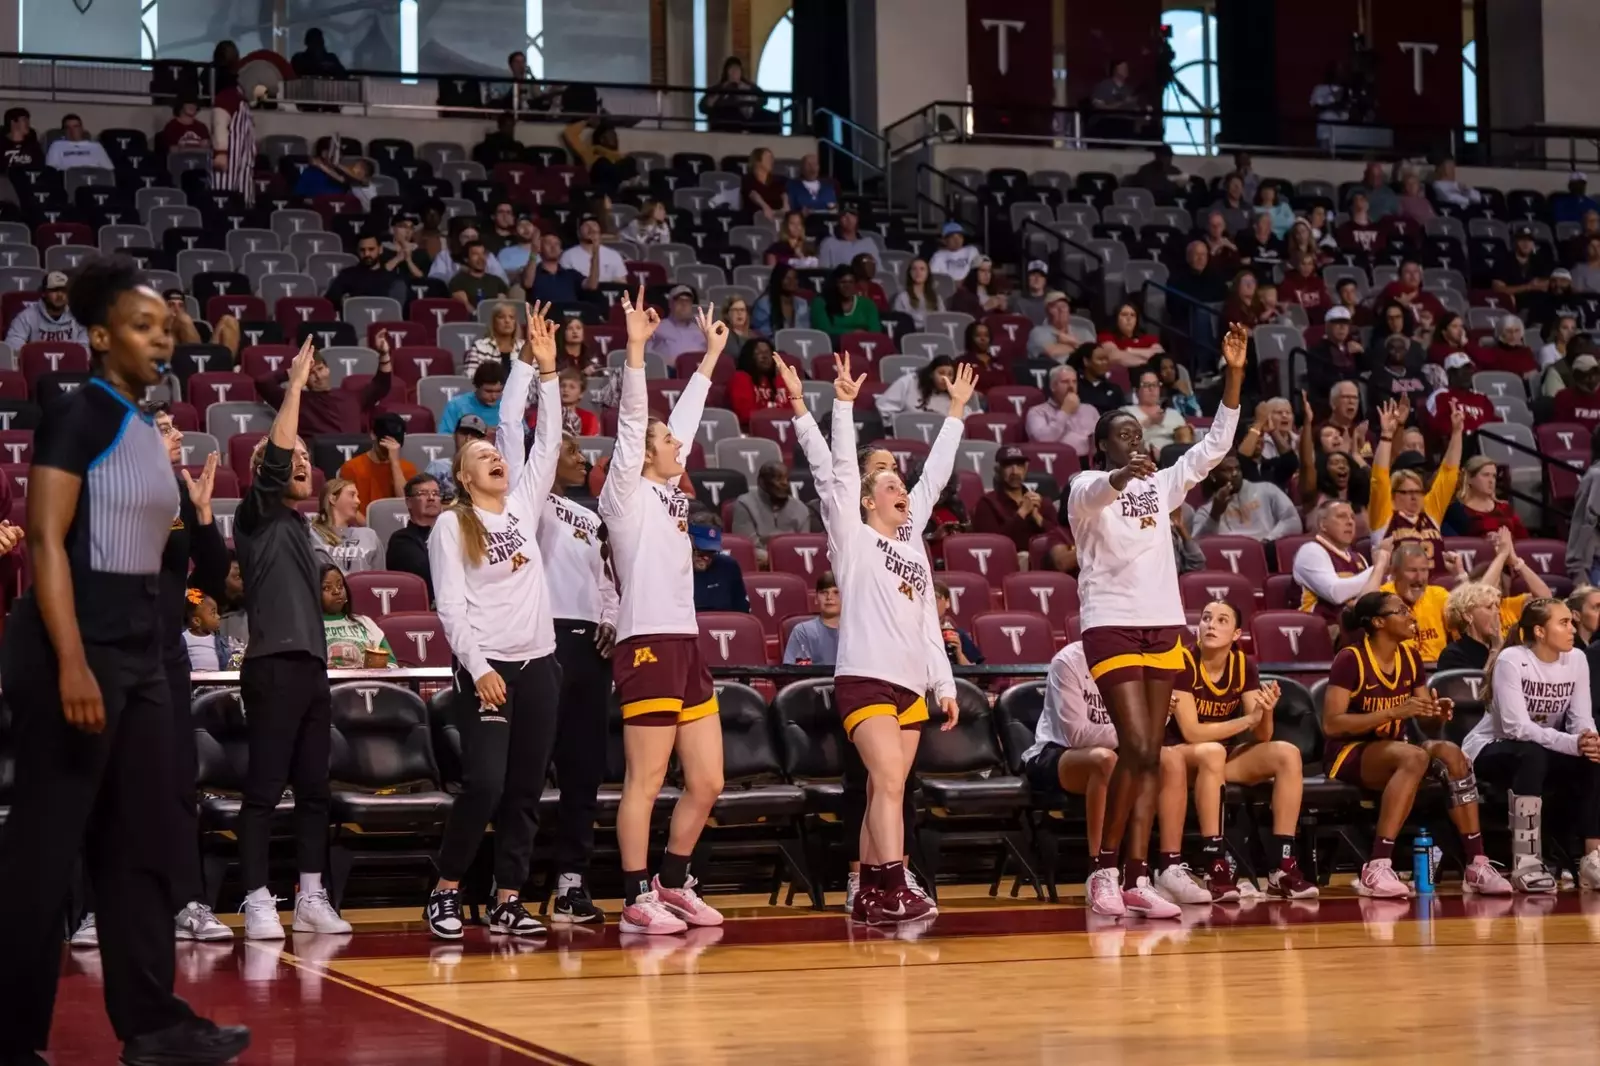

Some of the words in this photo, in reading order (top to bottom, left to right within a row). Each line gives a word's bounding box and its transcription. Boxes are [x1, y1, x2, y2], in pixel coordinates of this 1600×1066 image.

[981, 19, 1025, 76] T
[1398, 41, 1438, 96] T
[34, 193, 49, 203] T
[213, 197, 228, 208] T
[44, 212, 60, 224] T
[228, 217, 244, 229] T
[289, 219, 304, 233] T
[349, 221, 364, 234] T
[55, 233, 73, 245] T
[117, 235, 134, 248] T
[182, 237, 199, 249] T
[246, 239, 261, 253] T
[309, 240, 324, 254] T
[747, 233, 762, 250] T
[65, 255, 83, 267] T
[132, 257, 148, 271] T
[197, 260, 213, 272] T
[720, 254, 735, 269] T
[11, 277, 30, 291] T
[213, 282, 230, 296] T
[279, 283, 297, 297] T
[693, 273, 708, 289] T
[751, 275, 766, 291] T
[412, 286, 428, 300] T
[603, 291, 619, 307] T
[228, 304, 247, 320] T
[296, 307, 314, 321] T
[365, 308, 382, 322] T
[430, 309, 449, 325] T
[244, 331, 263, 346] T
[882, 321, 897, 339] T
[943, 322, 958, 341] T
[1003, 324, 1018, 341] T
[317, 332, 337, 348] T
[389, 331, 407, 349] T
[458, 333, 476, 351] T
[594, 336, 612, 354] T
[796, 340, 812, 358] T
[859, 342, 876, 361] T
[922, 344, 938, 360] T
[44, 353, 64, 371] T
[190, 355, 211, 374] T
[264, 356, 284, 371] T
[340, 358, 358, 376] T
[413, 358, 433, 377] T
[1030, 369, 1047, 389] T
[210, 384, 232, 403] T
[1008, 396, 1026, 416] T
[1495, 406, 1511, 424] T
[1575, 407, 1600, 419] TRO
[232, 414, 252, 433] T
[700, 421, 718, 441] T
[771, 421, 791, 442] T
[916, 424, 933, 443] T
[988, 424, 1008, 445] T
[1557, 432, 1573, 450] T
[4, 444, 28, 464] T
[740, 451, 760, 474] T
[966, 452, 984, 473] T
[1037, 453, 1057, 474] T
[703, 481, 724, 505] T
[488, 529, 527, 565] ENERGY
[794, 547, 818, 573] T
[969, 549, 992, 574] T
[1221, 550, 1242, 574] T
[1532, 553, 1552, 572] T
[885, 556, 927, 596] ENERGY
[371, 588, 398, 615] T
[756, 588, 781, 616] T
[1030, 587, 1054, 614] T
[406, 631, 434, 662] T
[709, 630, 736, 660] T
[1000, 626, 1026, 655] T
[1279, 626, 1305, 655] T
[814, 685, 835, 709] T
[1463, 677, 1482, 700] T
[355, 688, 379, 714] T
